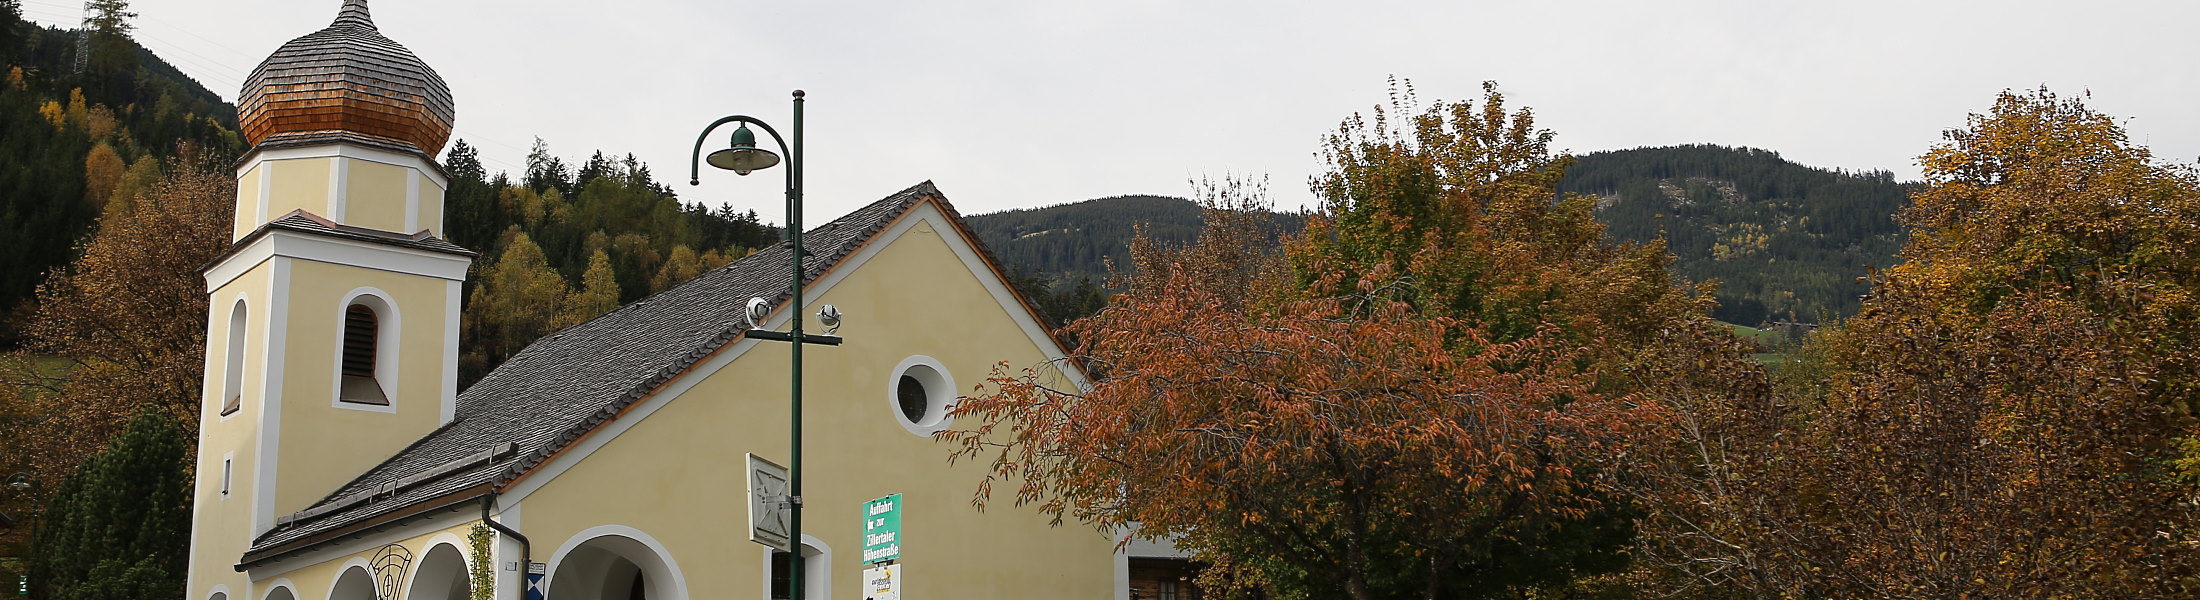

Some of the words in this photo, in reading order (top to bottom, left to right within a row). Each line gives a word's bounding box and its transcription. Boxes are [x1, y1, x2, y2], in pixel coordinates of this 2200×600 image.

[869, 500, 893, 517] Auffahrt
[876, 517, 885, 527] zur
[866, 530, 895, 547] Zillertaler
[863, 543, 899, 562] Höhenstraße
